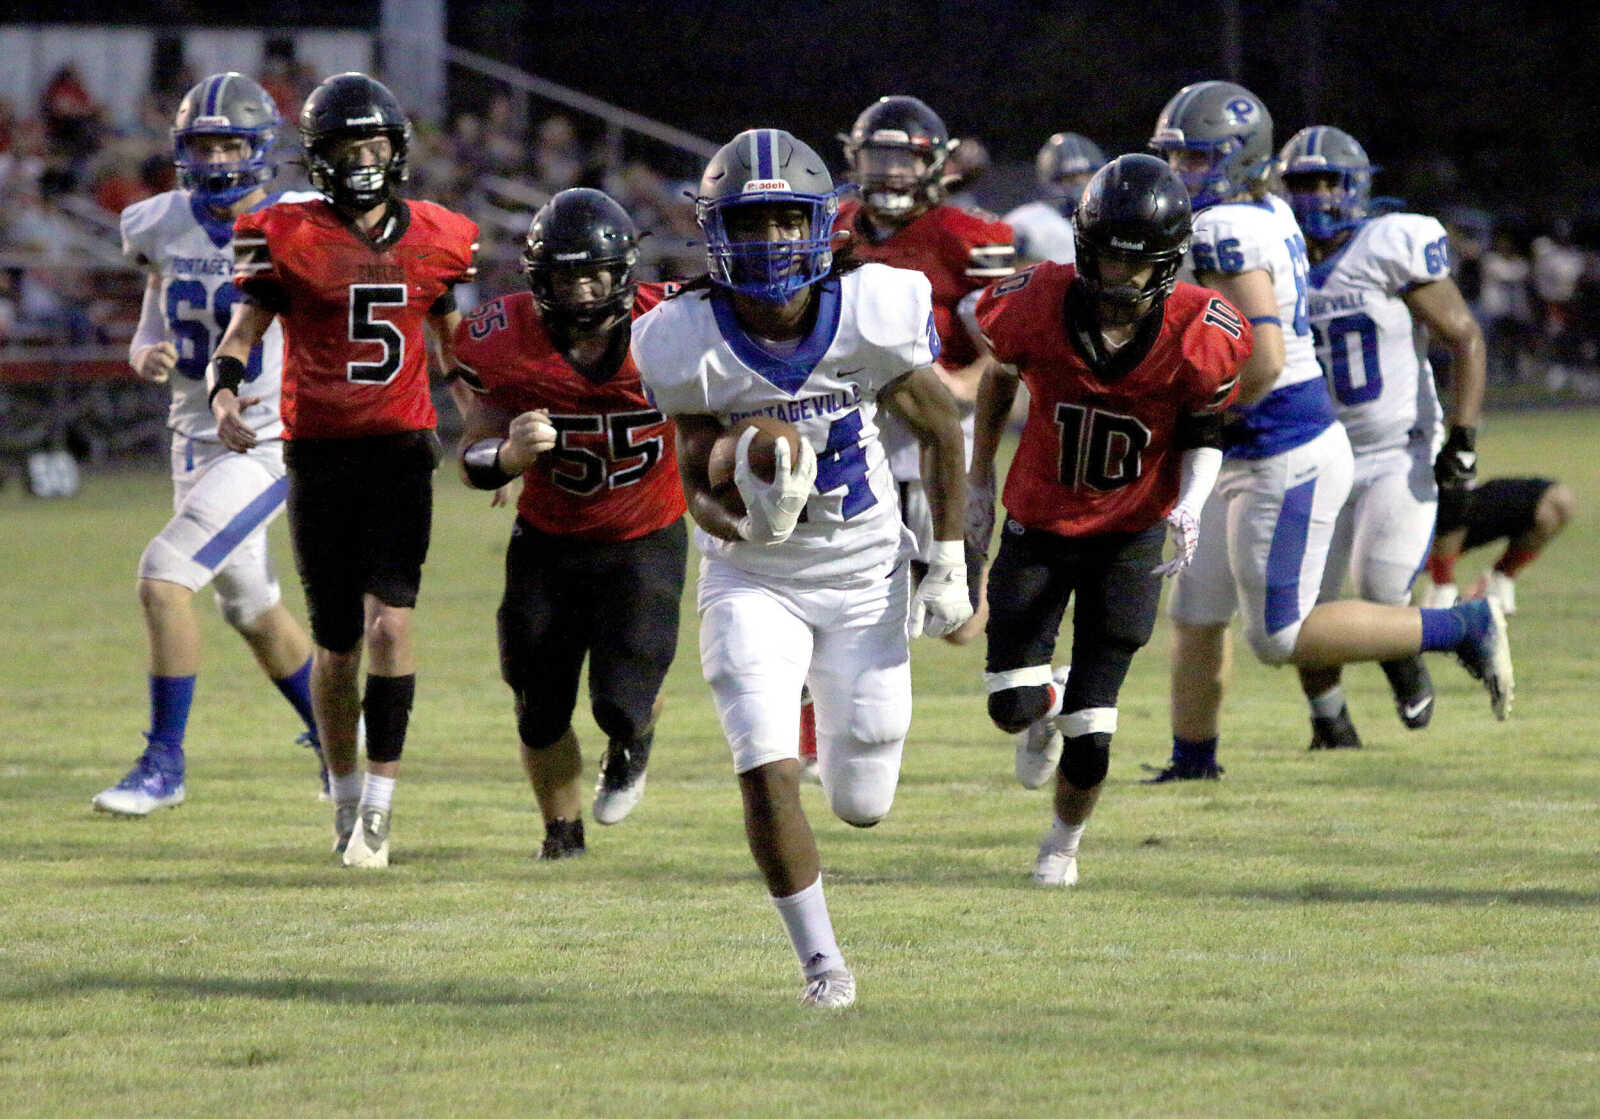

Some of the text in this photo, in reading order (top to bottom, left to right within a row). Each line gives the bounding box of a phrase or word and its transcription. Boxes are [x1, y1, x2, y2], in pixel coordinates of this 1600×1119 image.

[346, 283, 408, 385] 5
[1202, 297, 1244, 339] 10
[1310, 312, 1385, 406] 0
[548, 408, 667, 497] 55
[1053, 402, 1152, 494] 10
